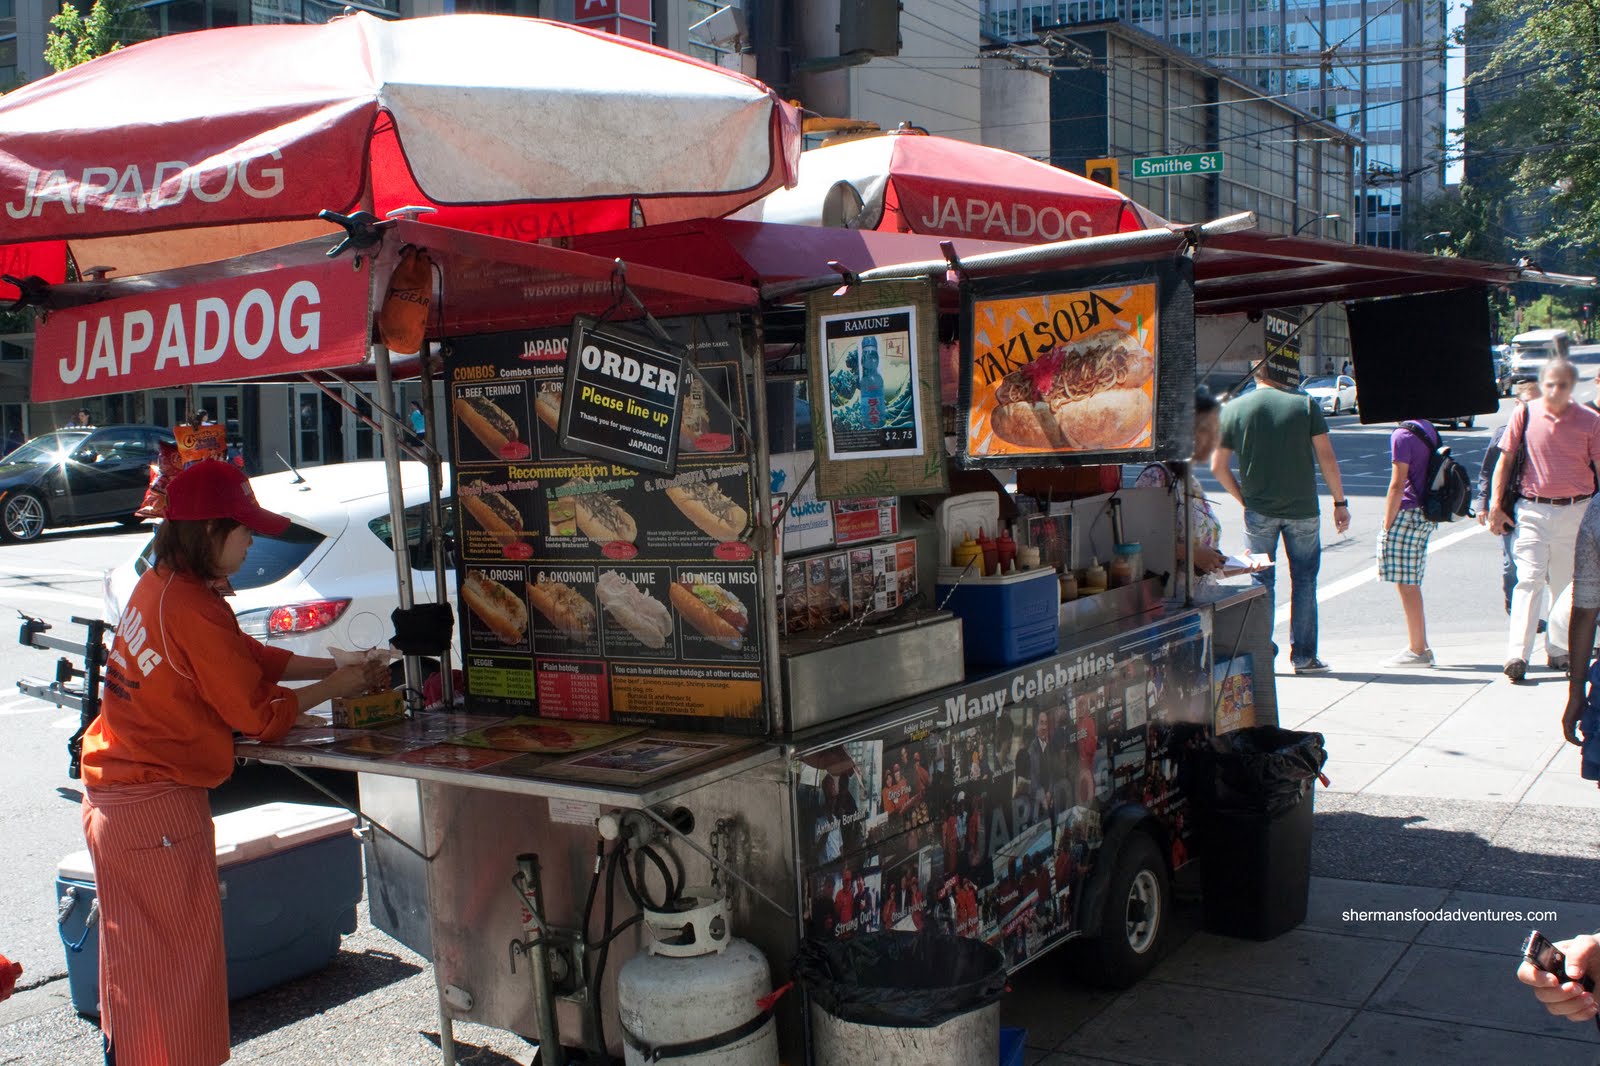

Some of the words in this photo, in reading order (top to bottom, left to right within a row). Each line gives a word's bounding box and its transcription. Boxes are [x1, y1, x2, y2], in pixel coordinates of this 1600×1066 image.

[1140, 159, 1193, 175] Smithe
[1199, 155, 1217, 170] St
[6, 148, 285, 219] JAPADOG
[922, 195, 1093, 241] JAPADOG
[58, 280, 322, 385] JAPADOG
[844, 317, 890, 332] RAMUNE
[1266, 315, 1288, 337] PICK
[523, 337, 570, 357] JAPADO
[454, 364, 496, 381] COMBOS
[500, 368, 532, 378] Combos
[581, 345, 678, 397] ORDER
[457, 389, 465, 399] 1.
[465, 387, 483, 398] BEEF
[484, 384, 521, 396] TERIMAYO
[541, 383, 550, 393] 2.
[582, 386, 624, 412] Please
[626, 398, 650, 419] line
[652, 410, 670, 428] up
[580, 411, 599, 424] Thank
[599, 418, 611, 427] you
[610, 420, 619, 429] for
[619, 424, 633, 434] your
[632, 427, 667, 442] cooperation.
[885, 430, 913, 441] $2.75
[628, 439, 664, 455] JAPADOG
[508, 463, 609, 479] Recommendation
[789, 501, 827, 518] twitter
[490, 569, 523, 581] OROSHI
[540, 571, 549, 582] 8.
[550, 571, 595, 583] OKONOMI
[620, 572, 631, 585] 9.
[632, 572, 656, 585] UME
[699, 572, 726, 584] NEGI
[728, 572, 758, 585] MISO
[473, 659, 494, 667] VEGGIE
[543, 663, 558, 671] Plain
[559, 664, 579, 673] hotdog
[638, 667, 652, 675] have
[653, 668, 680, 677] different
[680, 669, 705, 678] hotdogs
[713, 670, 730, 678] other
[731, 670, 760, 679] location.
[943, 688, 1007, 727] Many
[1011, 652, 1115, 703] Celebrities
[903, 721, 920, 735] Ashley
[834, 917, 859, 937] Strung
[860, 910, 873, 924] Out
